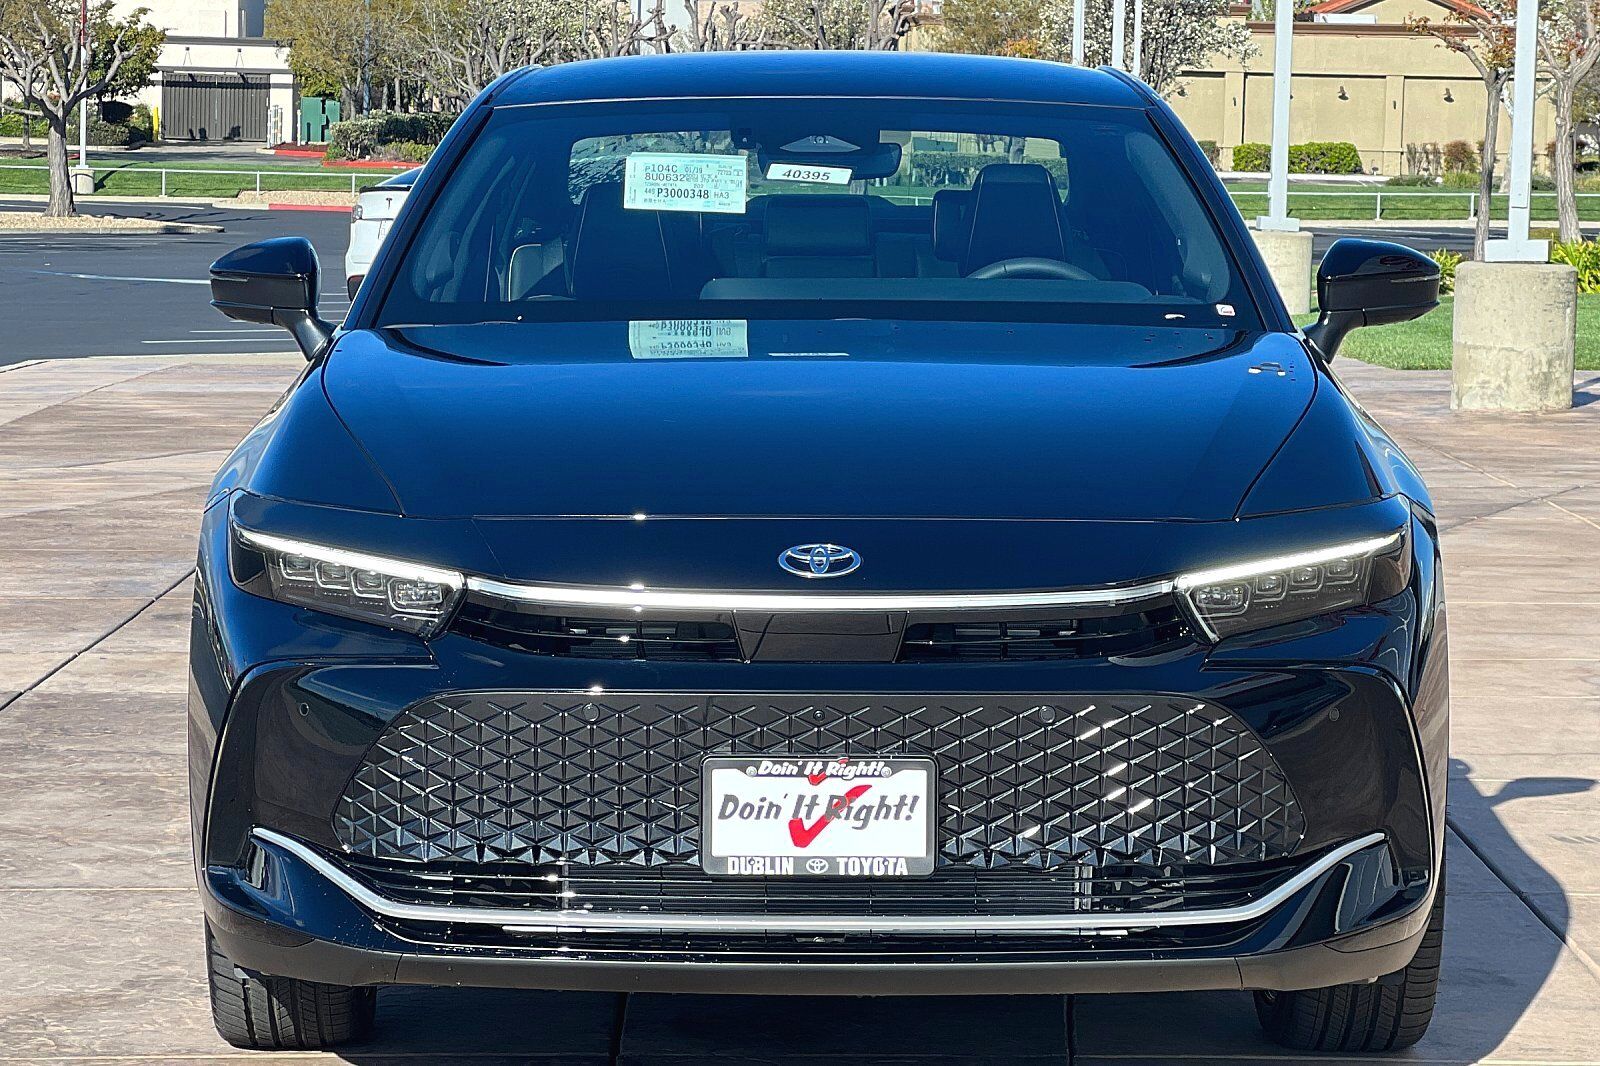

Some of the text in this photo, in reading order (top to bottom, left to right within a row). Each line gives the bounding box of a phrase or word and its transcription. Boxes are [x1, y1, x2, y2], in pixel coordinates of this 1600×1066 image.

[644, 173, 686, 182] 8U0632
[782, 169, 831, 181] 40395
[657, 188, 710, 199] P3000348
[713, 191, 730, 200] HA3
[757, 760, 886, 780] Doin' It Right!
[717, 793, 920, 831] Doin' It Right!
[727, 856, 909, 876] DUBLIN TOYOTA
